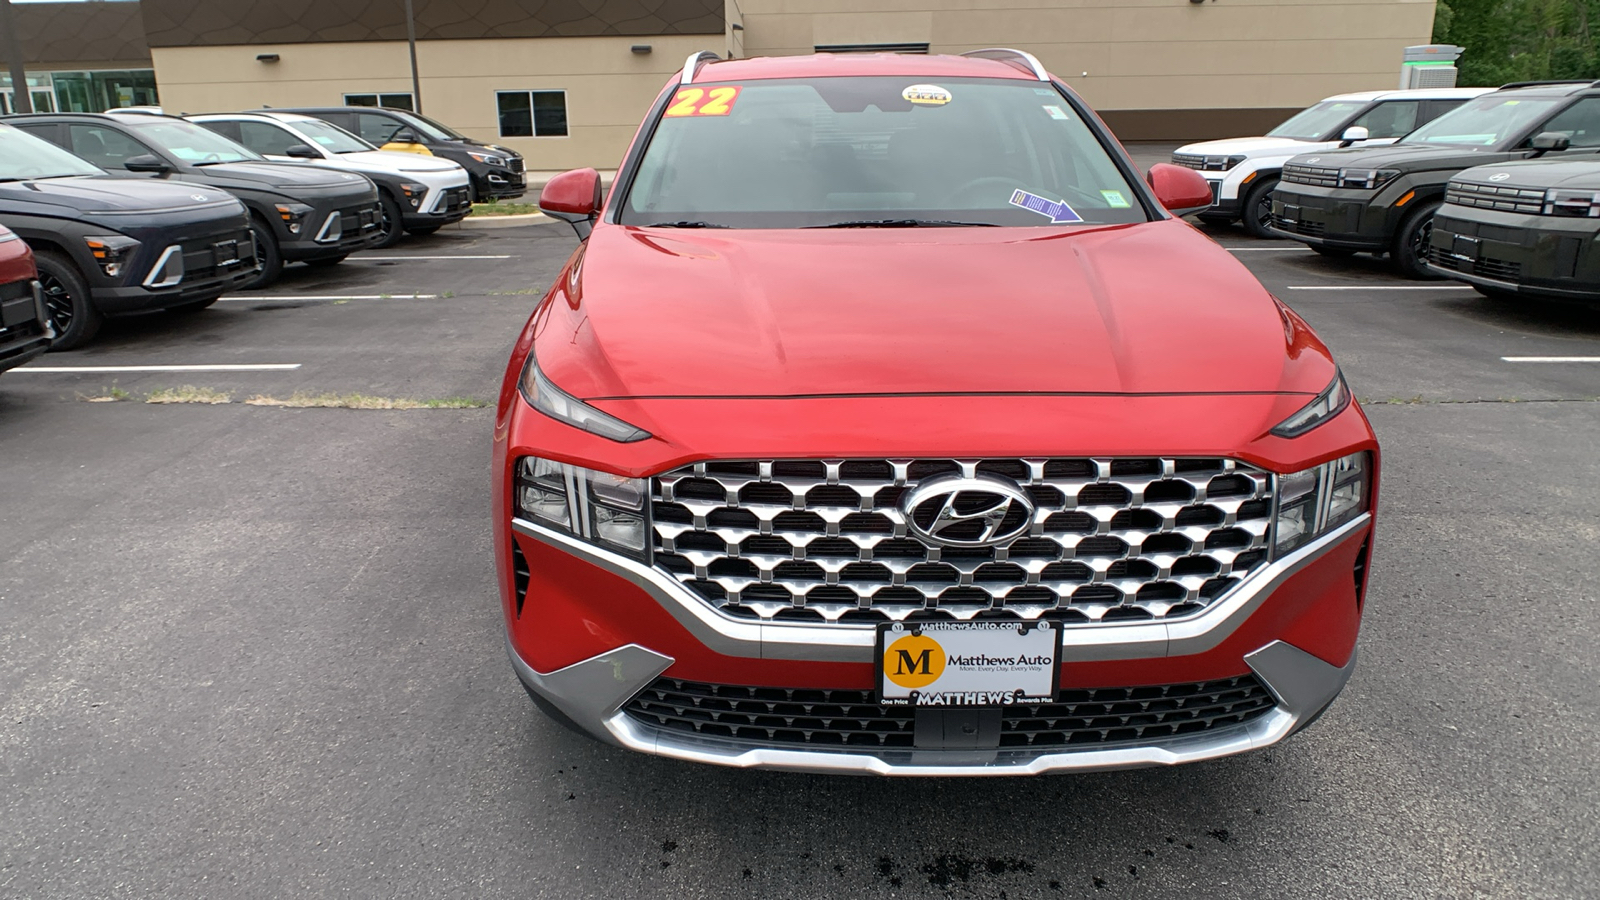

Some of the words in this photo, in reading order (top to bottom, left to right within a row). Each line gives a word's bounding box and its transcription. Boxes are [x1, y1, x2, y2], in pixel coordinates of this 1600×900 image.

[667, 87, 737, 116] 22
[919, 621, 1023, 631] MatthewsAuto.com
[893, 649, 935, 676] M
[947, 654, 1015, 666] Matthews
[1016, 654, 1052, 666] Auto
[1010, 665, 1028, 673] Every
[916, 691, 1014, 706] MATTHEWS
